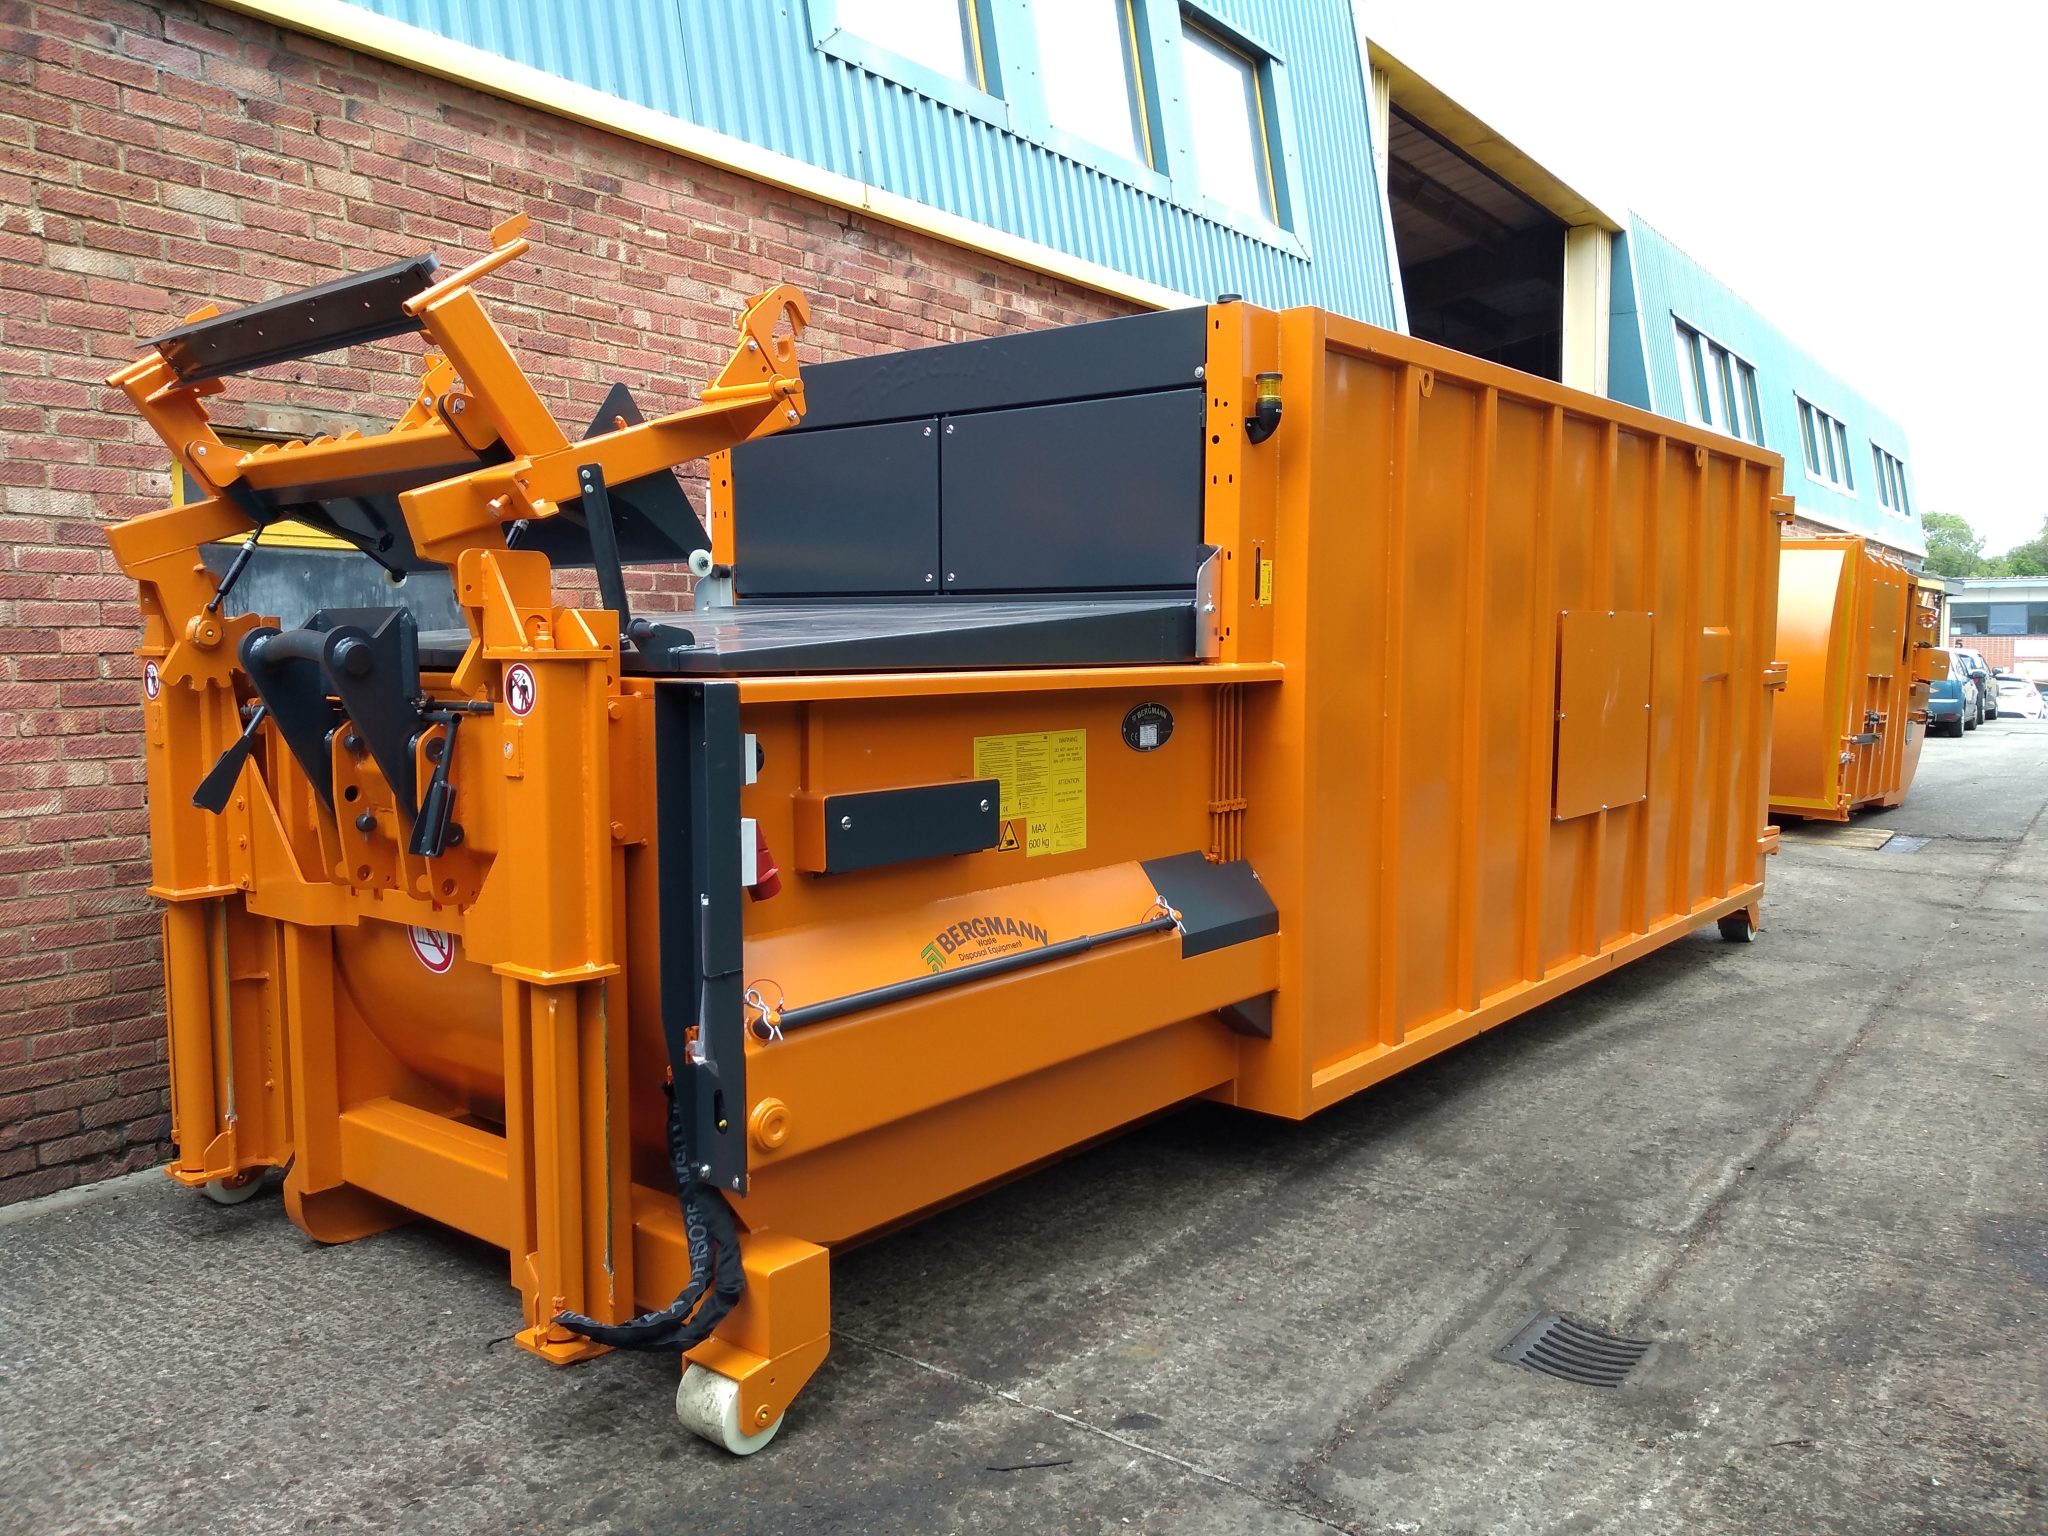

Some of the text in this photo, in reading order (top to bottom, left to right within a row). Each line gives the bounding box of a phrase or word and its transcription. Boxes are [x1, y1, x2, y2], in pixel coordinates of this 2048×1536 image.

[1955, 640, 1963, 648] 5
[1137, 707, 1167, 719] BERGMANN
[1031, 823, 1048, 834] MAX
[1028, 839, 1041, 849] 600
[1041, 838, 1050, 848] kg
[936, 916, 1049, 955] BERGMANN
[976, 936, 998, 947] Waste
[958, 940, 1023, 962] Disposal Equipment
